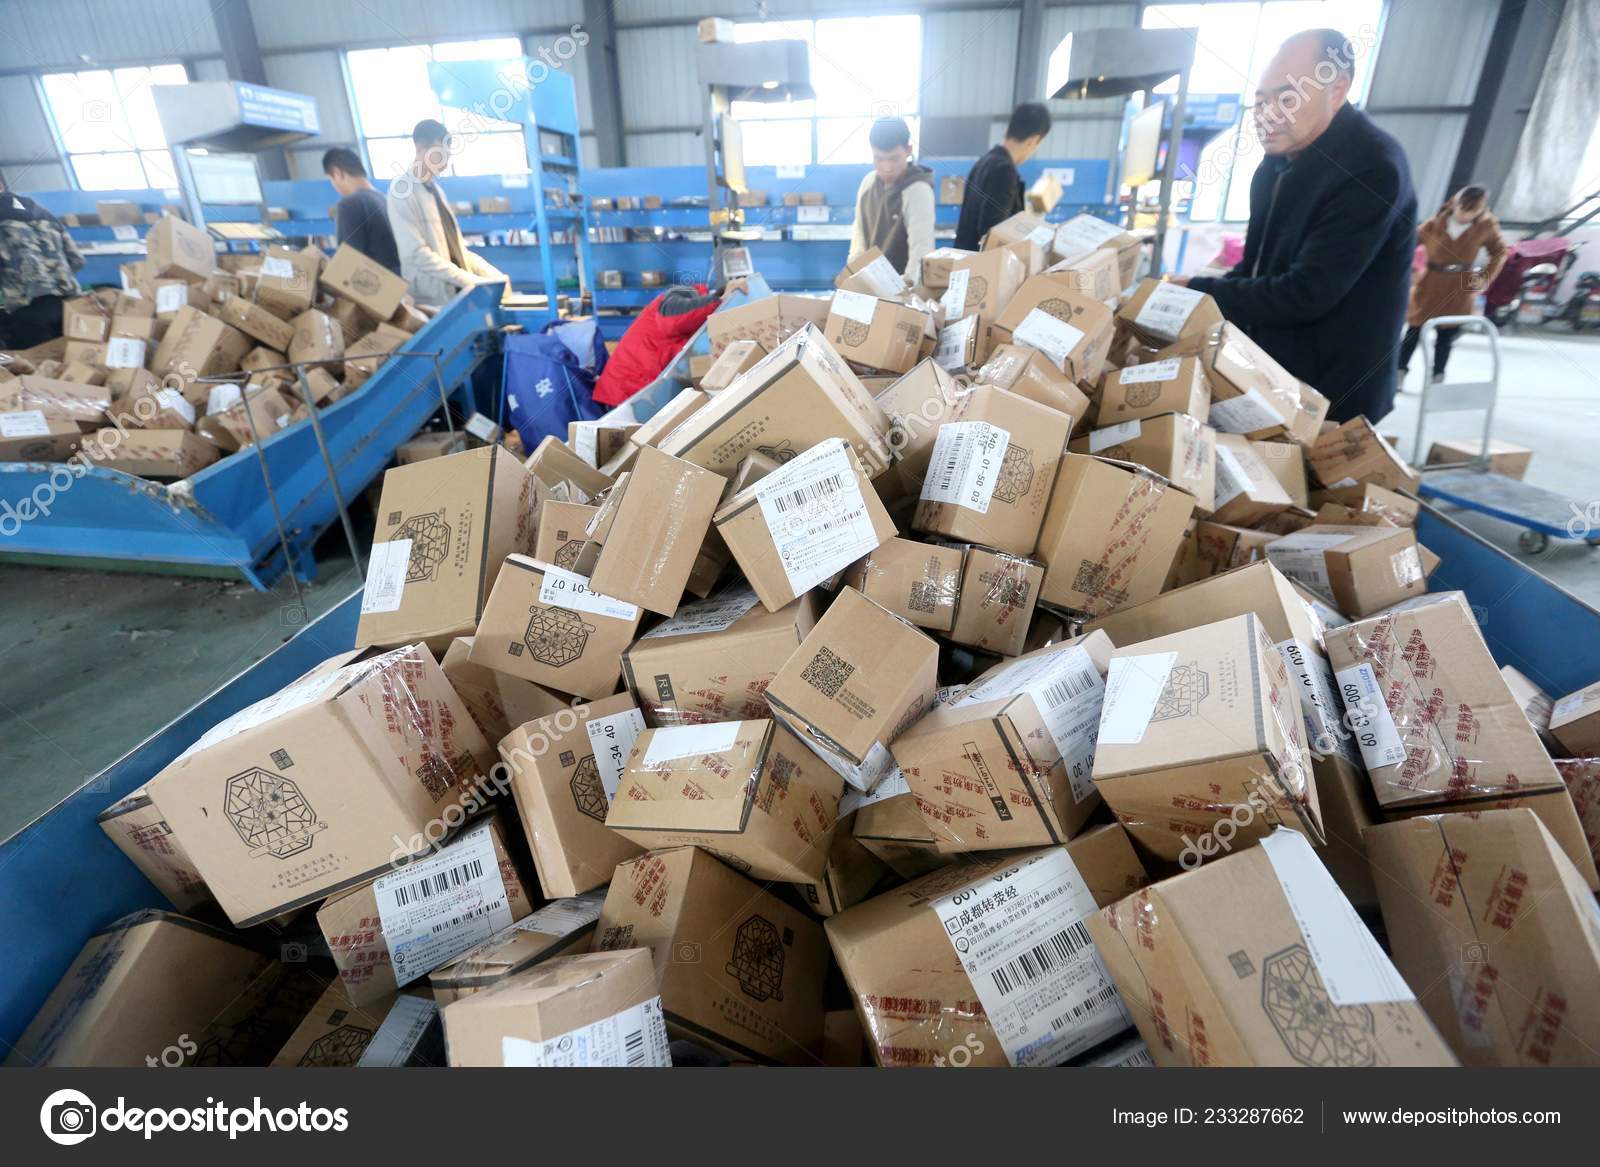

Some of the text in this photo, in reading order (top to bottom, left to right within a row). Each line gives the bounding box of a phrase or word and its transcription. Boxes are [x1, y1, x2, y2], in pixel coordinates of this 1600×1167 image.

[975, 458, 990, 486] 01-50
[970, 490, 980, 502] 03
[551, 578, 566, 589] 07
[1342, 681, 1362, 708] 600-
[1359, 731, 1377, 750] 09
[604, 725, 614, 738] 40
